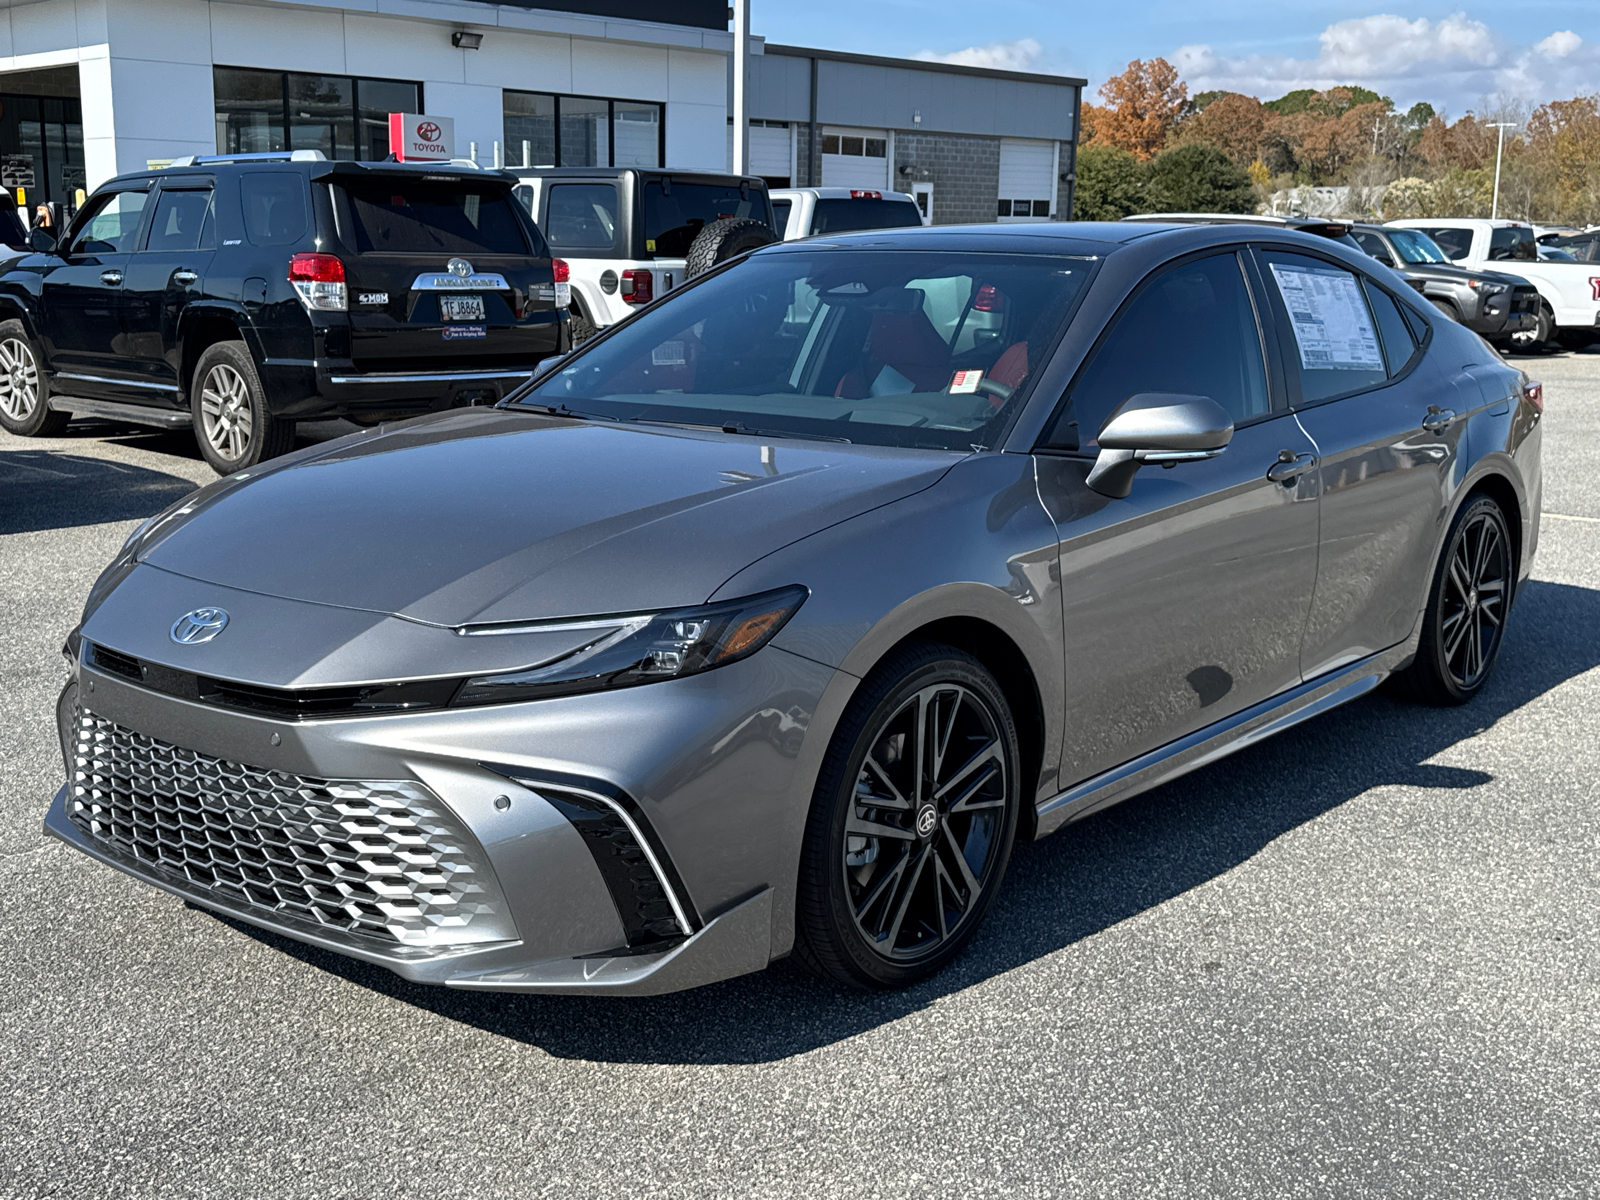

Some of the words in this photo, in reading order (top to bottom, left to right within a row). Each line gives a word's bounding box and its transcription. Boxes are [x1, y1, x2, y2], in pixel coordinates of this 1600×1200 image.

[413, 142, 446, 153] TOYOTA
[369, 293, 389, 303] MOM
[444, 301, 481, 315] TFJ8864
